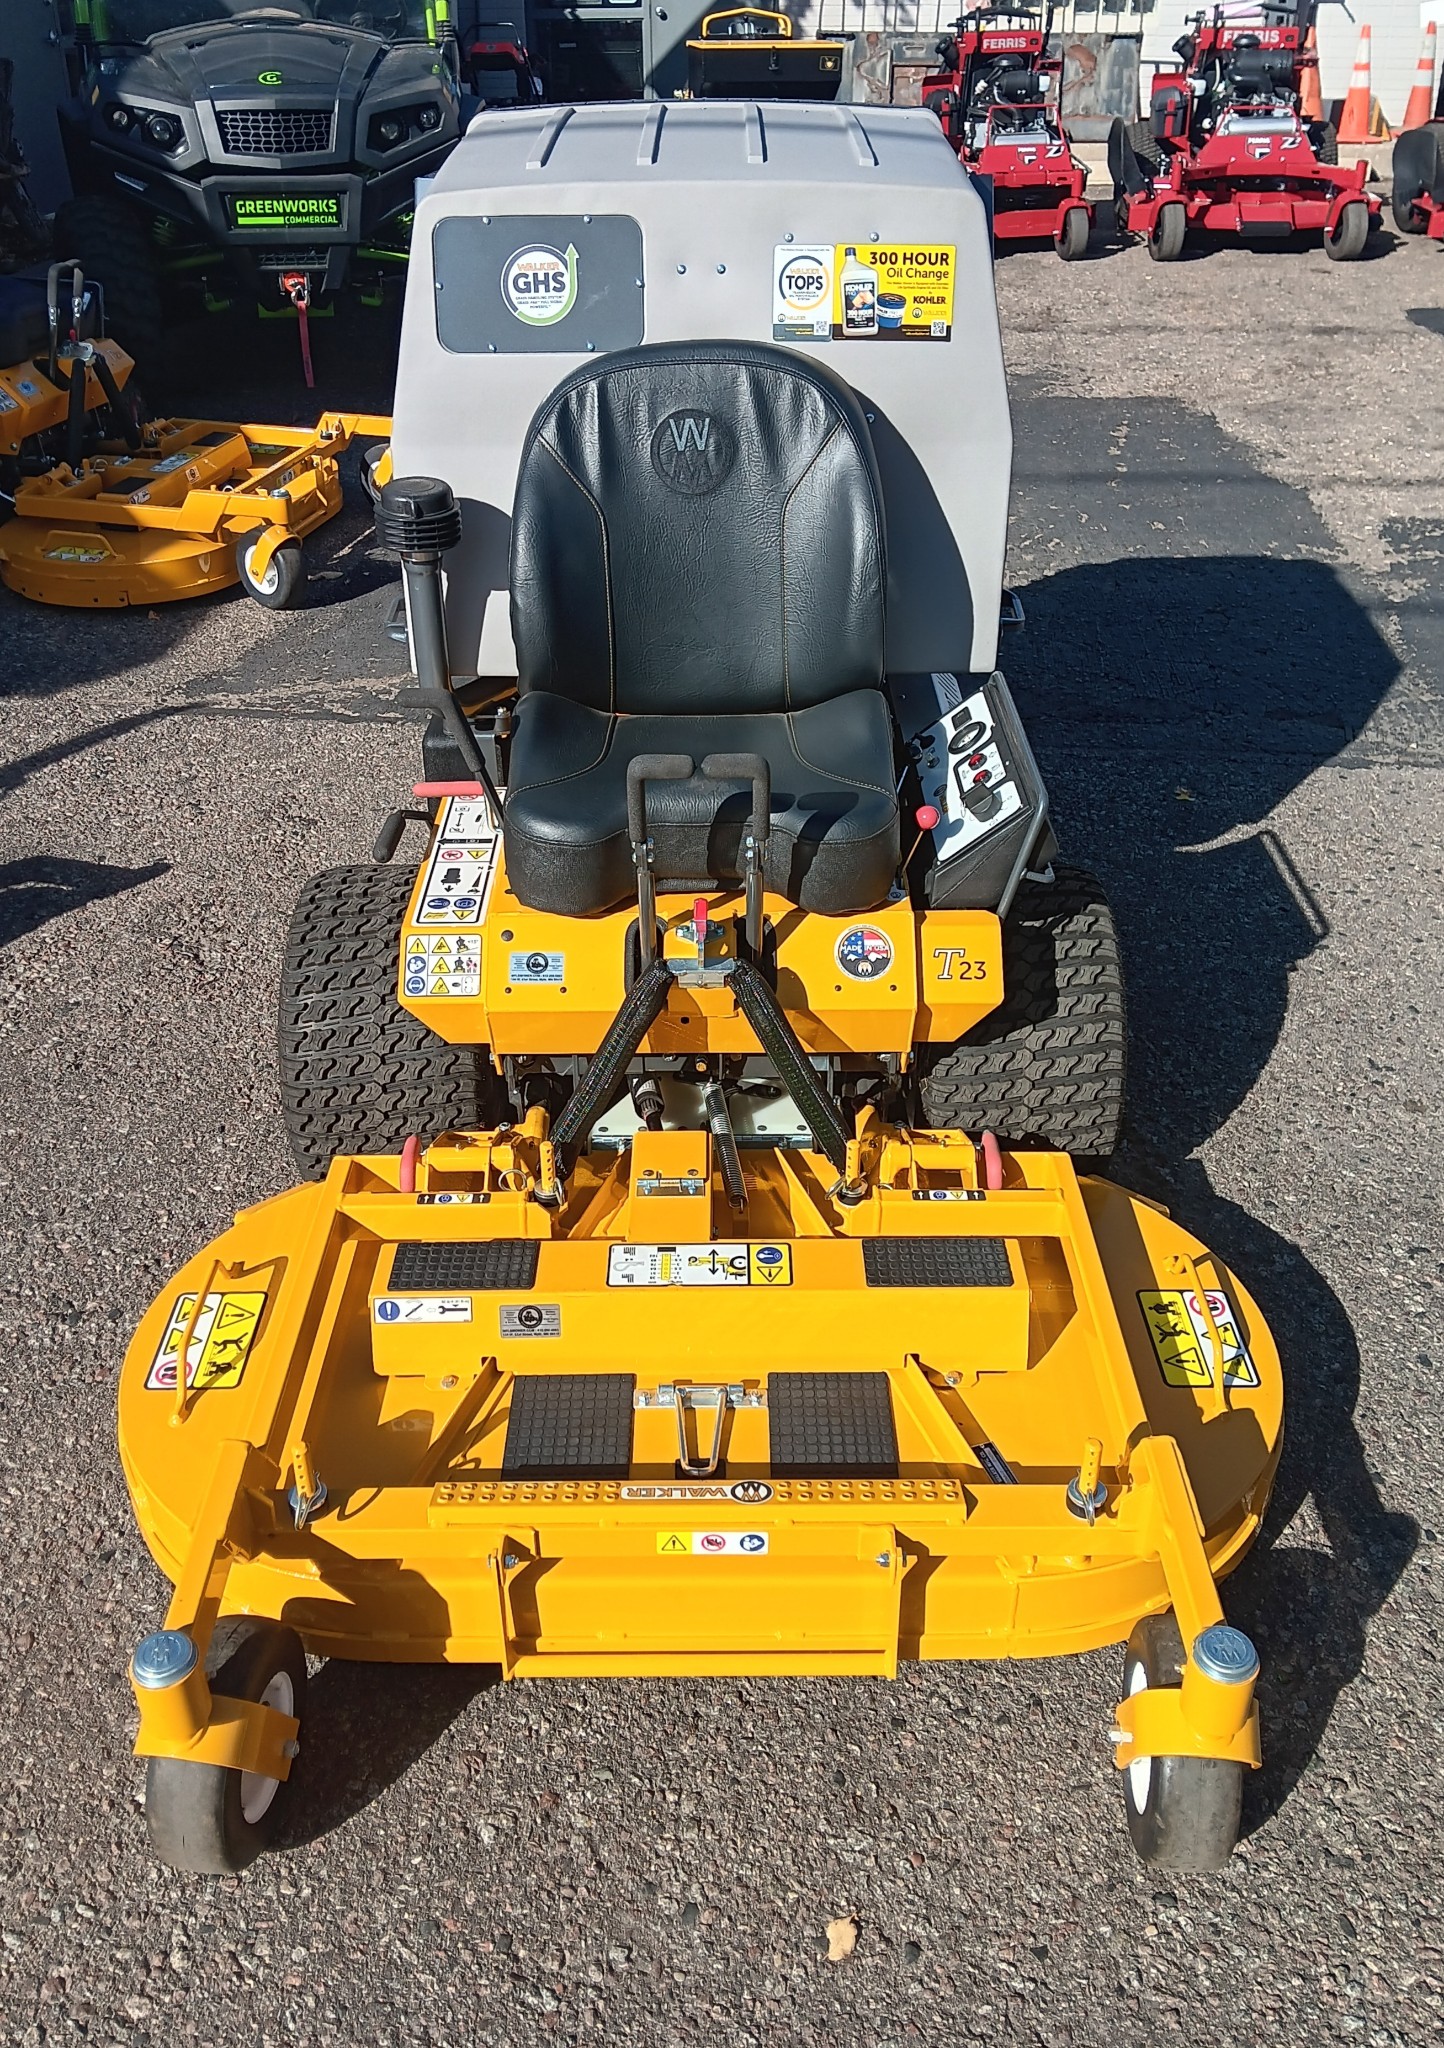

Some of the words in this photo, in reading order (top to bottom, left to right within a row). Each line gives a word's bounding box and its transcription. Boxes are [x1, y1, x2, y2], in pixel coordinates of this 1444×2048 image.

[983, 37, 1026, 49] FERRIS
[235, 199, 337, 214] GREENWORKS
[284, 215, 338, 224] COMMERCIAL
[869, 252, 898, 265] 300
[903, 252, 949, 266] HOUR
[517, 262, 560, 271] WALKER
[887, 268, 903, 278] Oil
[906, 268, 949, 281] Change
[512, 271, 566, 294] GHS
[786, 275, 823, 290] TOPS
[913, 296, 946, 305] KOHLER
[627, 1487, 728, 1498] WALKER
